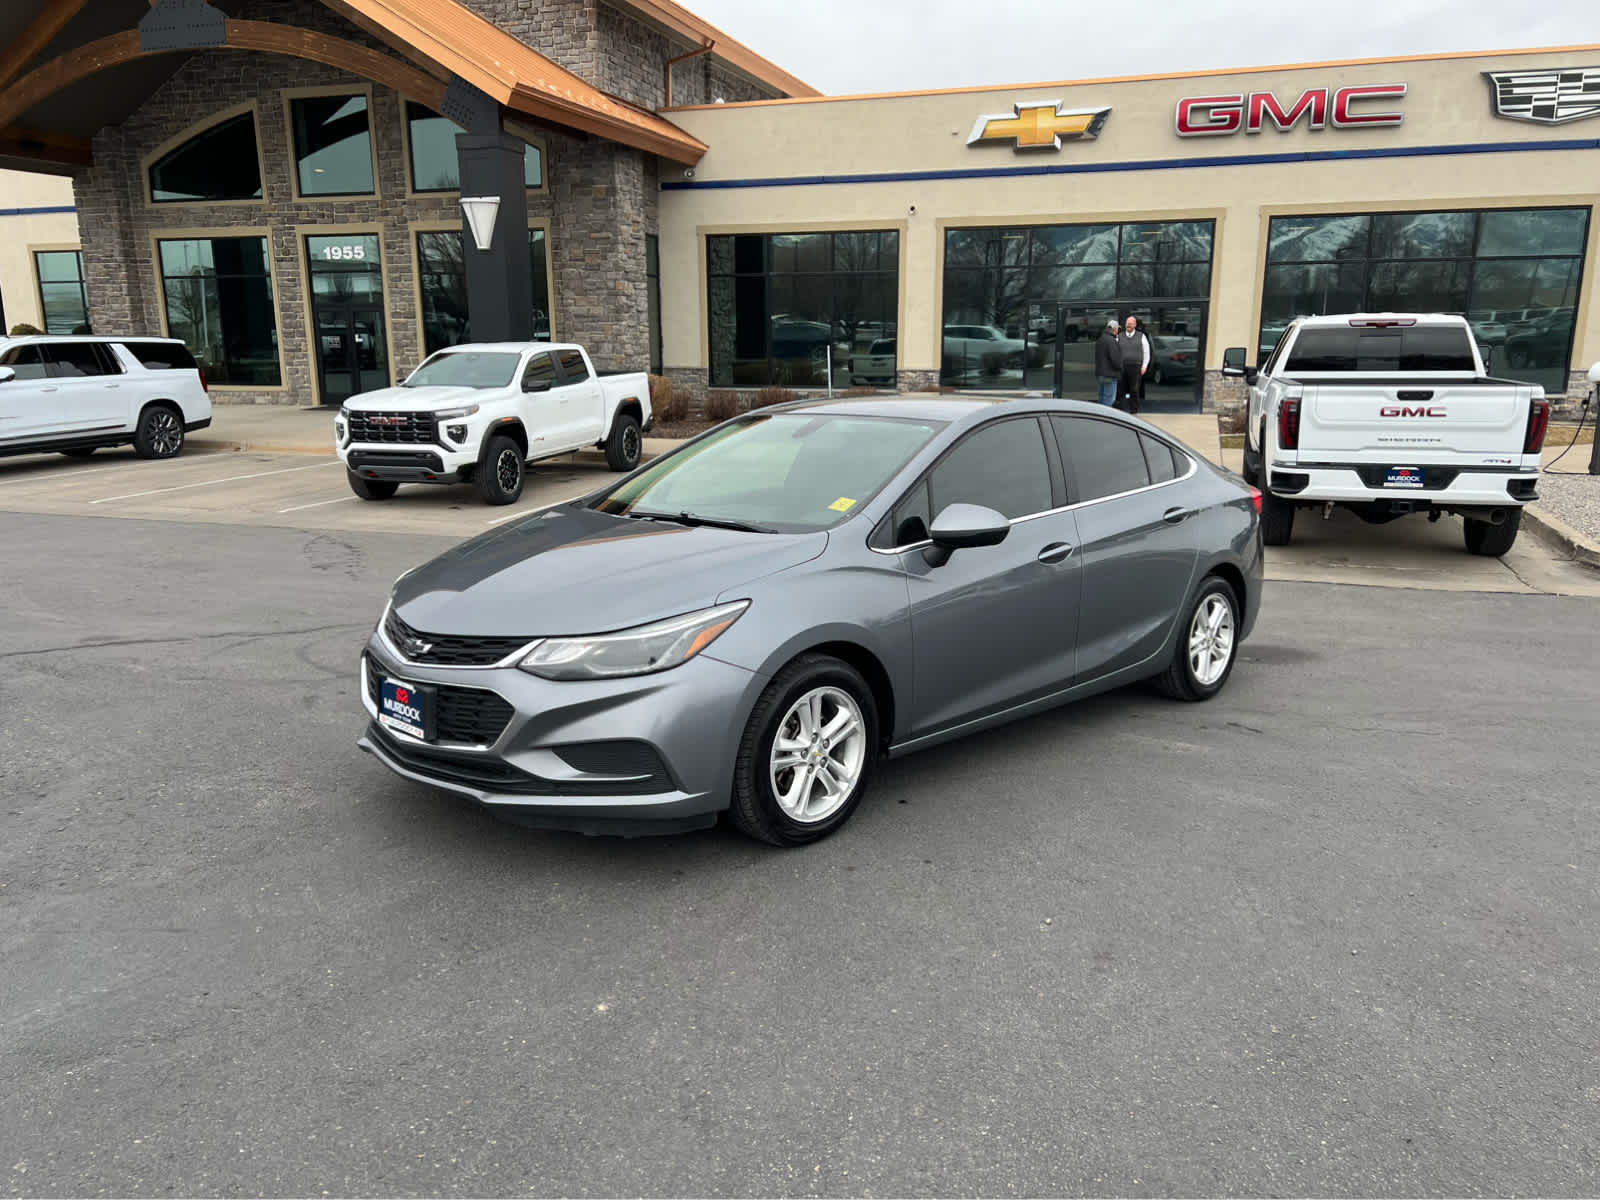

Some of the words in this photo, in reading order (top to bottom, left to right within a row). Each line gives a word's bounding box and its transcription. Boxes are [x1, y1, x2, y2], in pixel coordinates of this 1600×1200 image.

[1176, 83, 1407, 136] GMC
[323, 246, 365, 260] 1955
[1380, 406, 1447, 417] GMC
[383, 697, 422, 721] MURDOCK
